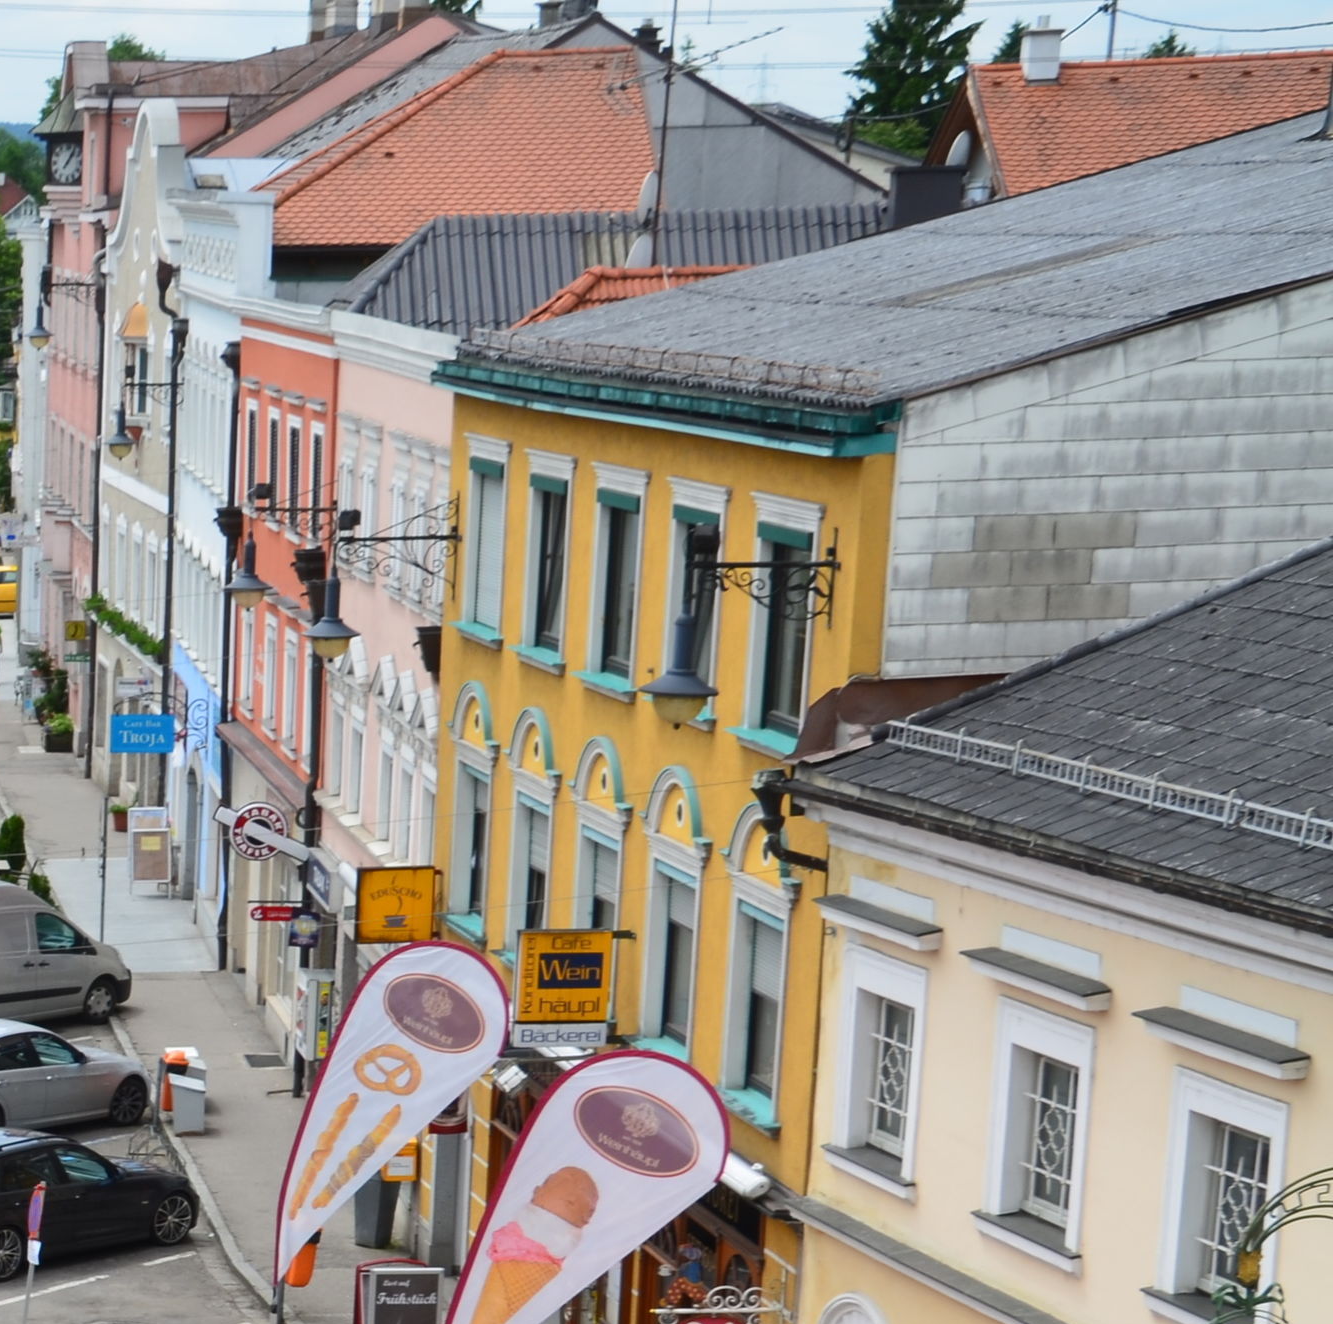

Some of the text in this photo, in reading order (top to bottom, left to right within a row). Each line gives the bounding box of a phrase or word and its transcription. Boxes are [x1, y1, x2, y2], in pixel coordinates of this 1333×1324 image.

[119, 730, 165, 746] TROJA
[245, 809, 284, 833] TABAK
[233, 828, 271, 857] TRAFIK
[370, 885, 422, 900] EDUSCHO
[552, 936, 591, 950] Cafe
[521, 936, 535, 1014] Konditorei
[541, 959, 600, 980] Wein
[539, 997, 600, 1016] häupl
[521, 1029, 601, 1043] Bäckerei
[376, 1293, 437, 1305] Frühstück
